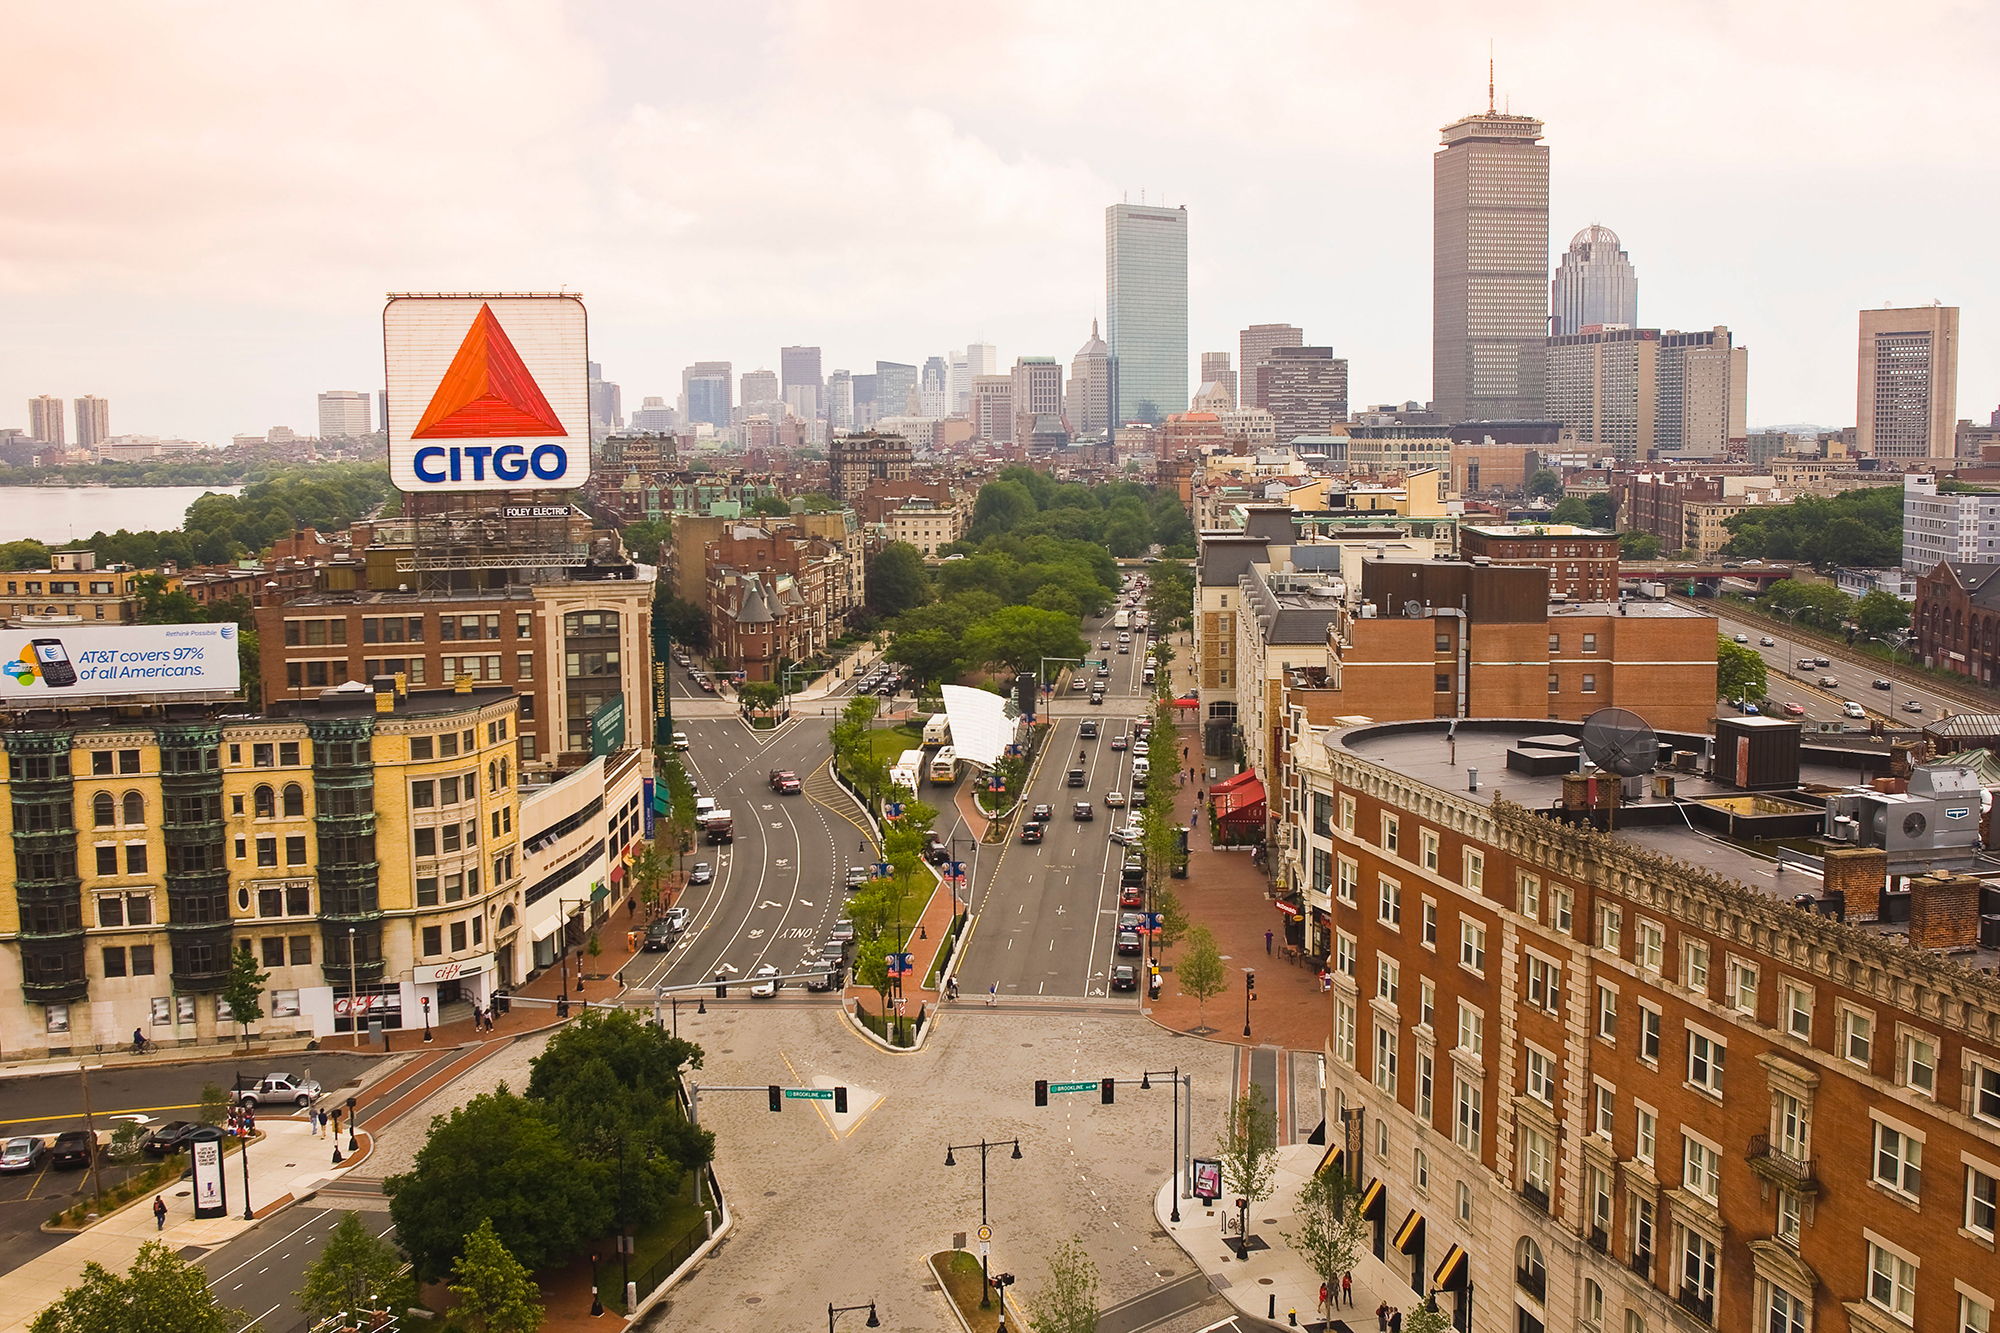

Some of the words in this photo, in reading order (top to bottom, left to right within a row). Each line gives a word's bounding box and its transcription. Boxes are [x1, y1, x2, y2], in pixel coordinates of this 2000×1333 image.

[413, 443, 568, 484] CITGO
[506, 508, 531, 516] FOLEY
[533, 507, 568, 516] ELECTRIC
[79, 650, 119, 664] AT&T
[120, 651, 170, 663] covers
[173, 647, 205, 661] 97%
[80, 666, 98, 680] of
[99, 666, 118, 680] all
[119, 664, 205, 679] Americans.
[656, 661, 665, 684] NOBLE
[657, 690, 666, 718] BARNES
[779, 928, 813, 939] ONLY
[1057, 1084, 1083, 1092] BROOKLINE
[1348, 1119, 1361, 1152] UNO
